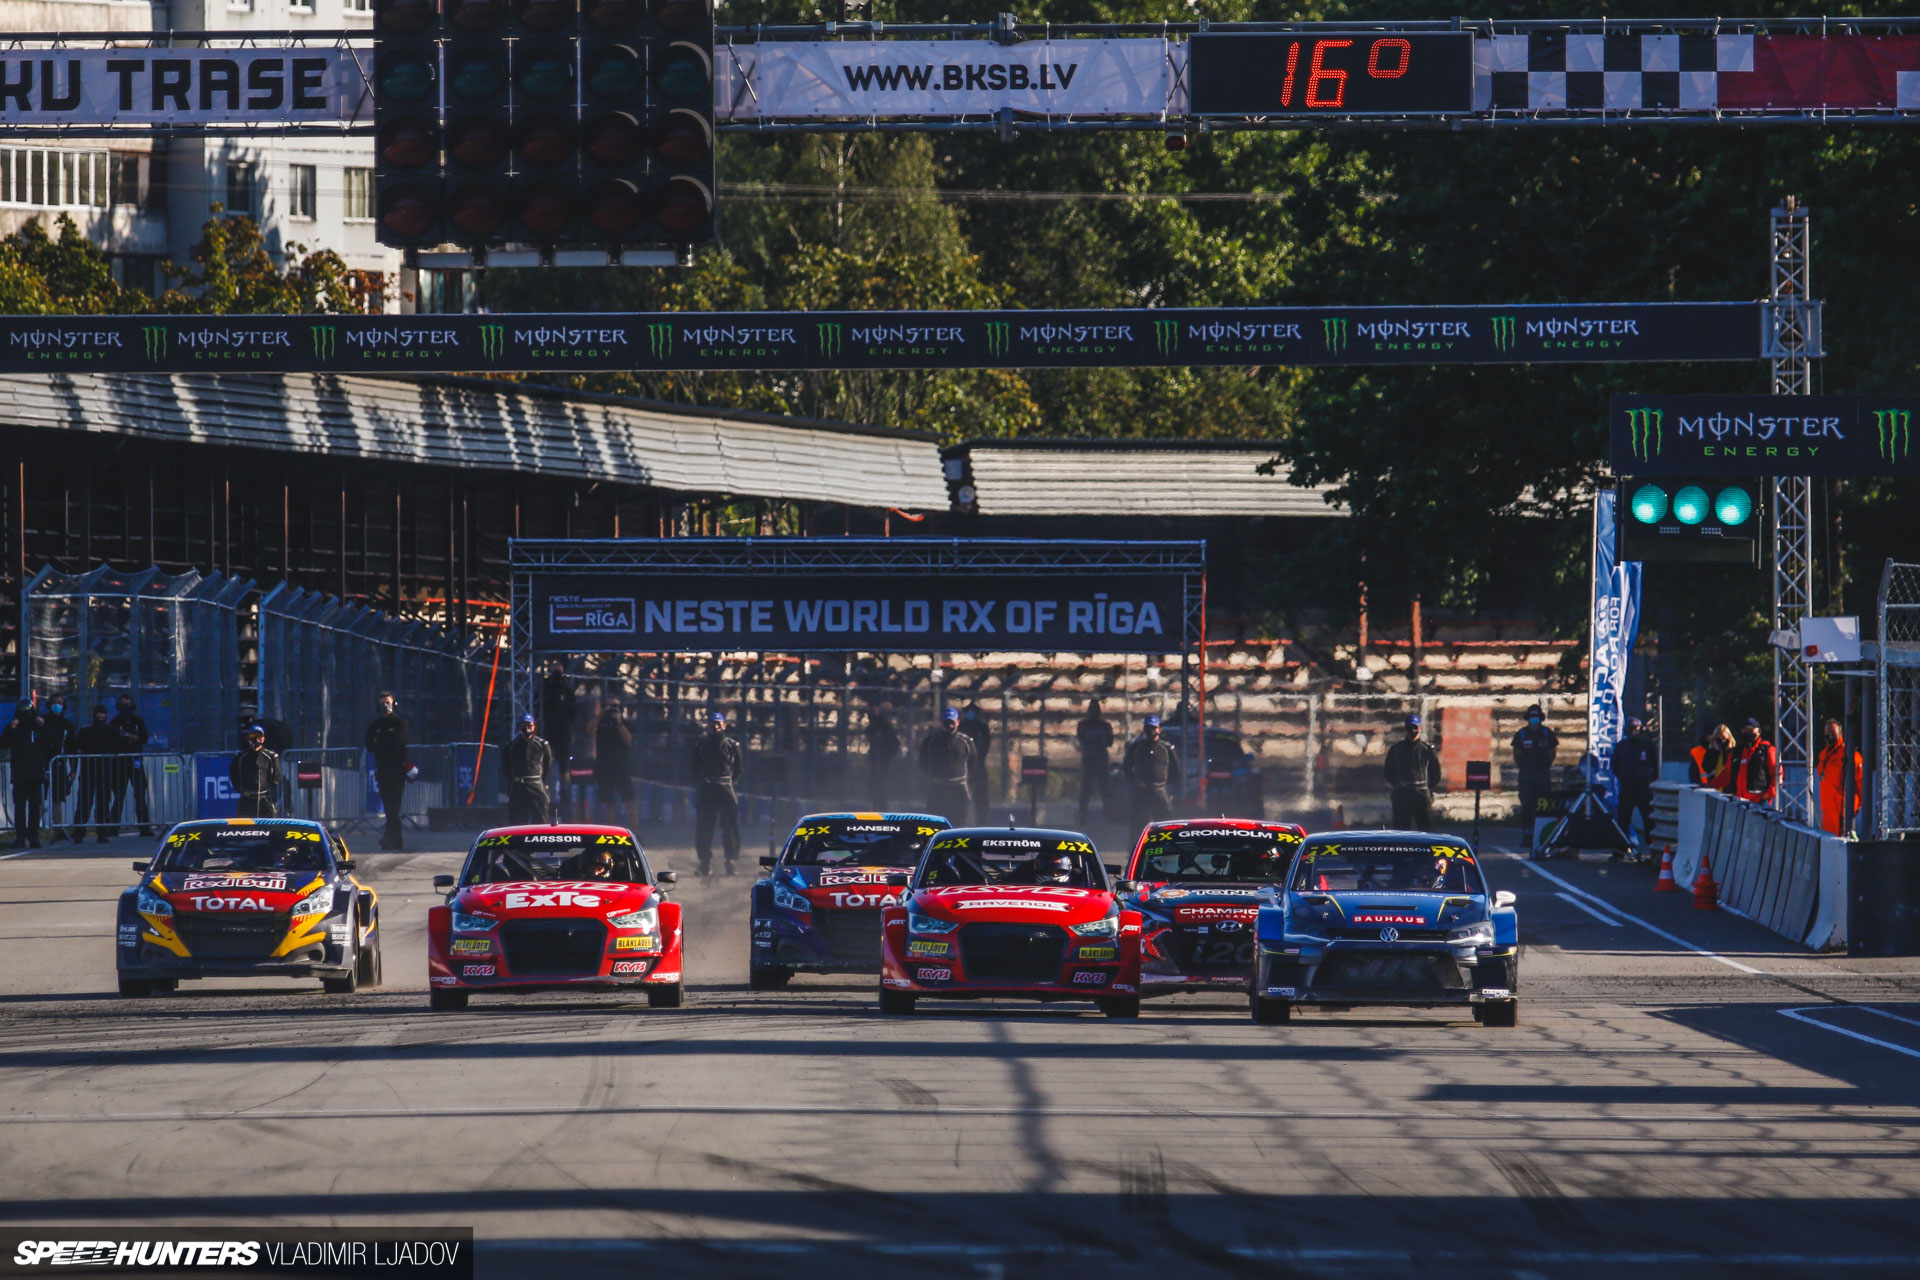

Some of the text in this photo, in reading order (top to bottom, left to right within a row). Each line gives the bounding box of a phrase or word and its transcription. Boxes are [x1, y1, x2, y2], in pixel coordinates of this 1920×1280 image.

[843, 63, 1077, 92] WWW.BKSB.LV
[0, 60, 81, 111] KU
[107, 58, 327, 111] TRASE
[1020, 321, 1133, 343] MONSTER
[1189, 319, 1302, 342] MONSTER
[1357, 317, 1470, 340] MONSTER
[1526, 315, 1639, 338] MONSTER
[10, 326, 122, 349] MONSTER
[178, 326, 291, 348] MONSTER
[346, 325, 459, 348] MONSTER
[514, 324, 628, 347] MONSTER
[683, 323, 796, 346] MONSTER
[852, 323, 965, 345] MONSTER
[1037, 346, 1117, 354] ENERGY
[1206, 345, 1285, 353] ENERGY
[1375, 342, 1454, 351] ENERGY
[1543, 340, 1623, 349] ENERGY
[27, 351, 106, 360] ENERGY
[195, 351, 274, 359] ENERGY
[363, 350, 442, 359] ENERGY
[531, 349, 610, 357] ENERGY
[700, 348, 780, 356] ENERGY
[869, 347, 948, 356] ENERGY
[1678, 411, 1844, 441] MONSTER
[1703, 445, 1820, 457] ENERGY
[644, 593, 1164, 635] NESTE WORLD RX OF RĪGA
[216, 830, 270, 838] HANSEN
[524, 835, 582, 844] LARSSON
[1178, 829, 1273, 840] GRONHOLM
[982, 839, 1041, 848] EKSTRÖM
[190, 895, 275, 912] TOTAL
[829, 892, 899, 908] TOTA
[1179, 907, 1259, 915] CHAMPIO
[1353, 916, 1425, 924] BAUHAUS
[463, 965, 496, 976] KYB
[613, 962, 646, 973] KYB
[917, 968, 951, 980] KYB
[1072, 971, 1107, 984] KYB
